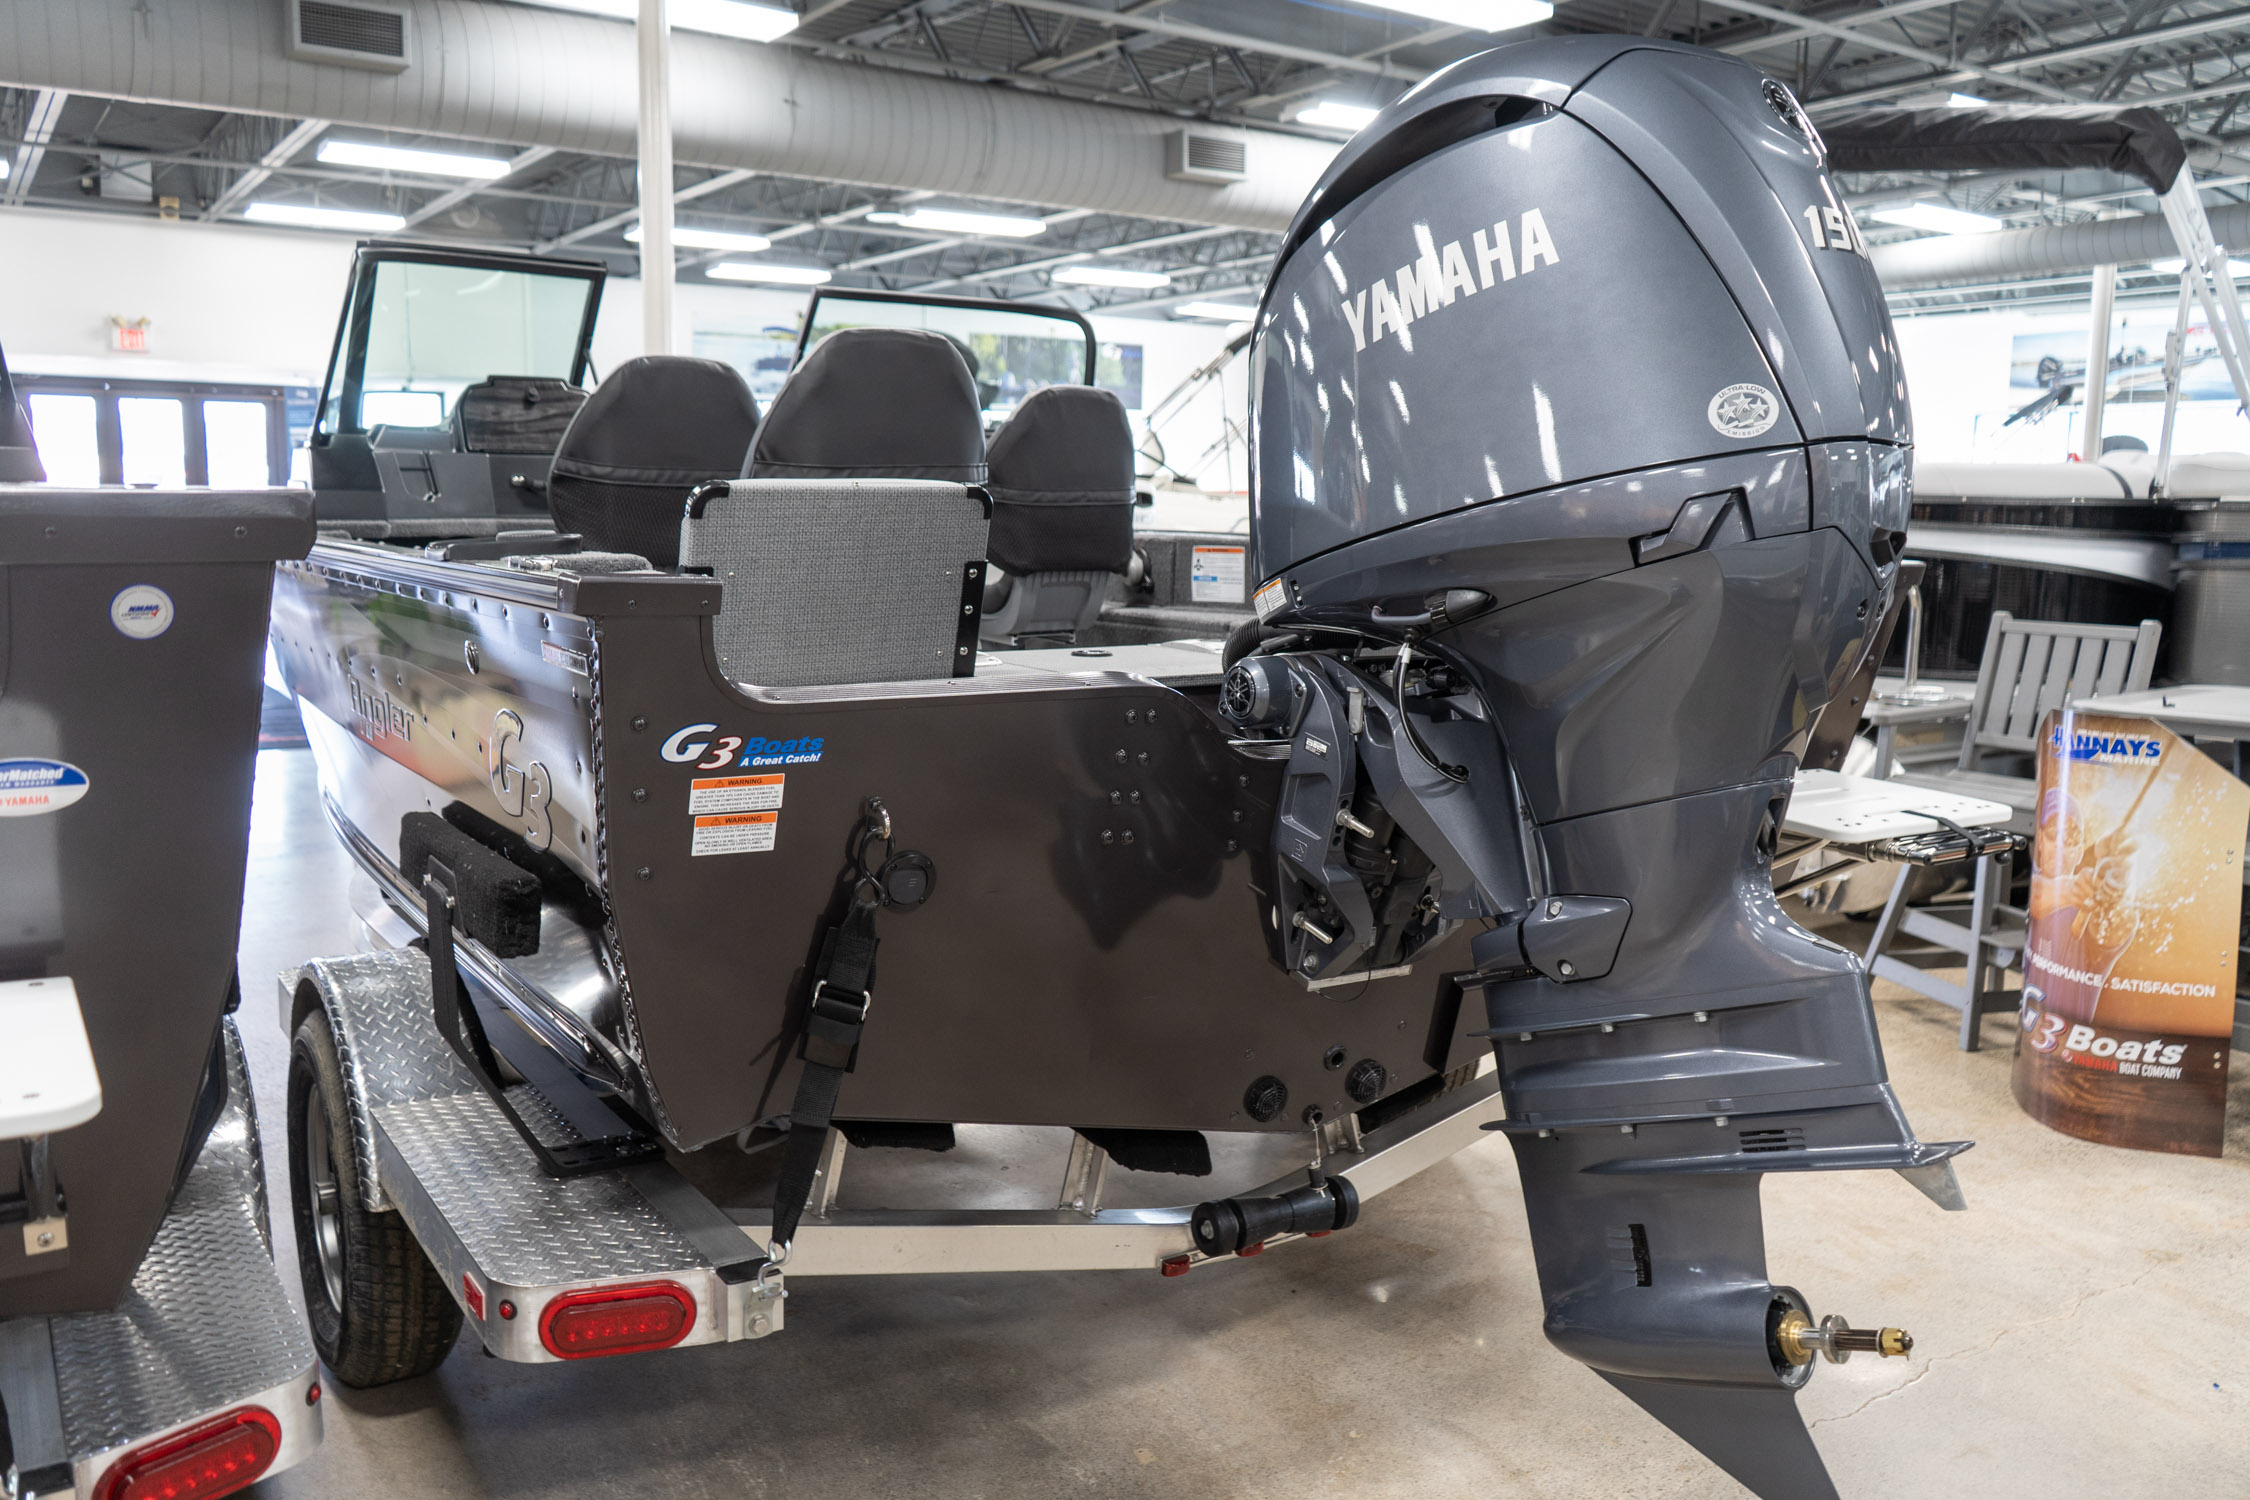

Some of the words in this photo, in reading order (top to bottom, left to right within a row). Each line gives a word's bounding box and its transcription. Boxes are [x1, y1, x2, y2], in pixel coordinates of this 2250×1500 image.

[1341, 207, 1560, 353] YAMAHA
[348, 674, 414, 742] Angler
[660, 723, 743, 770] G3
[744, 736, 824, 755] Boats
[740, 757, 749, 767] A
[752, 755, 783, 766] Great
[785, 752, 821, 764] Catch!
[489, 708, 553, 854] G3
[728, 778, 762, 786] WARNING
[725, 816, 762, 824] WARNING
[2110, 977, 2216, 998] SATISFACTION
[2022, 984, 2067, 1053] G3
[2065, 1024, 2188, 1065] Boats
[2072, 1054, 2118, 1073] YAMAHA
[2118, 1062, 2141, 1076] BOAT
[2141, 1064, 2183, 1080] COMPANY
